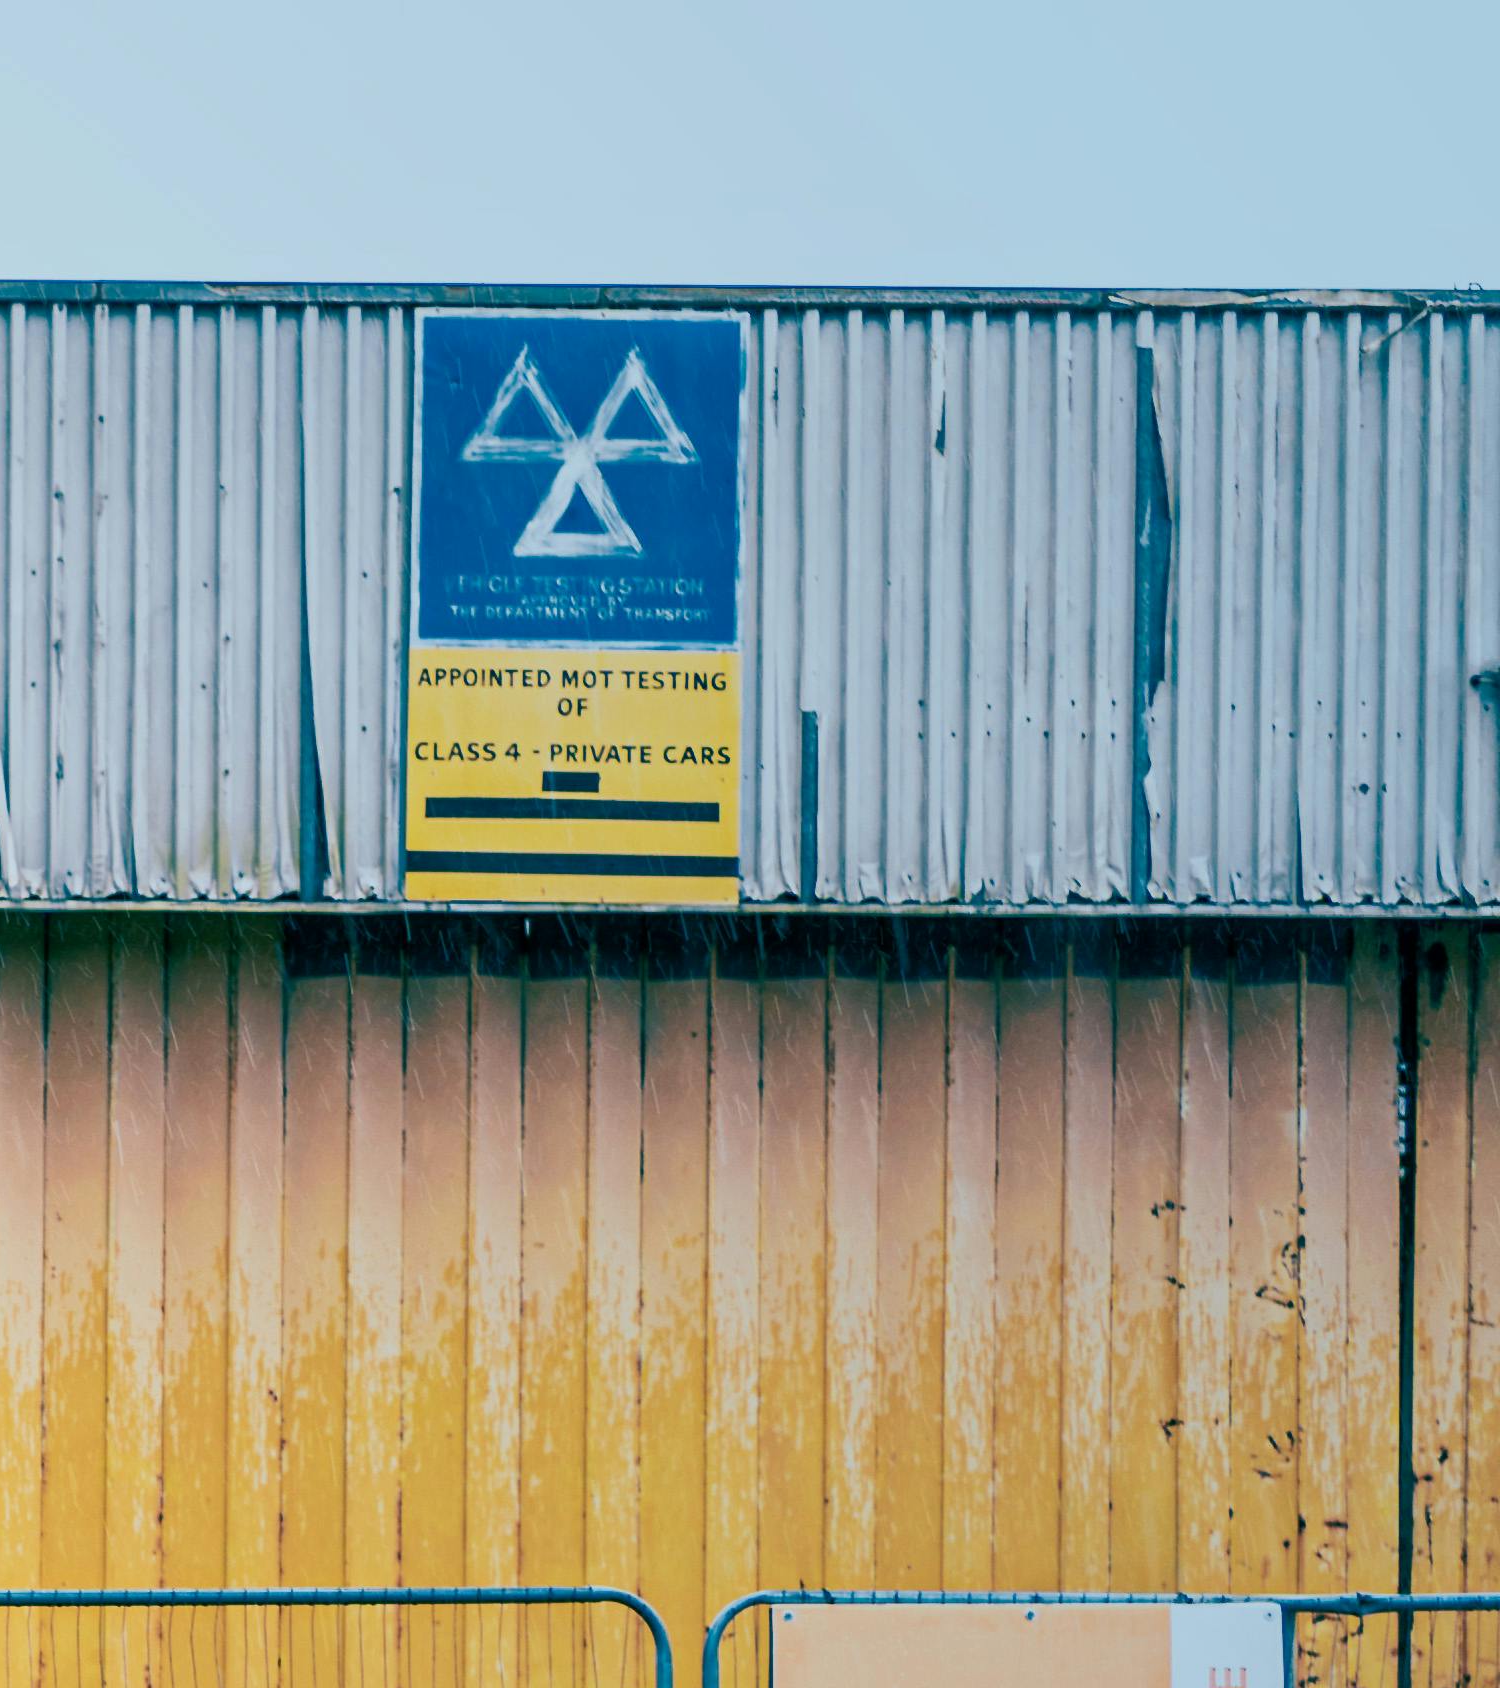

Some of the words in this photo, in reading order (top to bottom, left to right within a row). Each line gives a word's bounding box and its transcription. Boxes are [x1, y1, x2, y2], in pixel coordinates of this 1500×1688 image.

[417, 668, 552, 688] APPOINTED
[561, 670, 614, 690] MOT
[621, 671, 728, 691] TESTING
[557, 697, 589, 717] OF
[414, 742, 498, 762] CLASS
[504, 743, 522, 762] 4
[550, 744, 653, 764] PRIVATE
[662, 745, 732, 765] CARS
